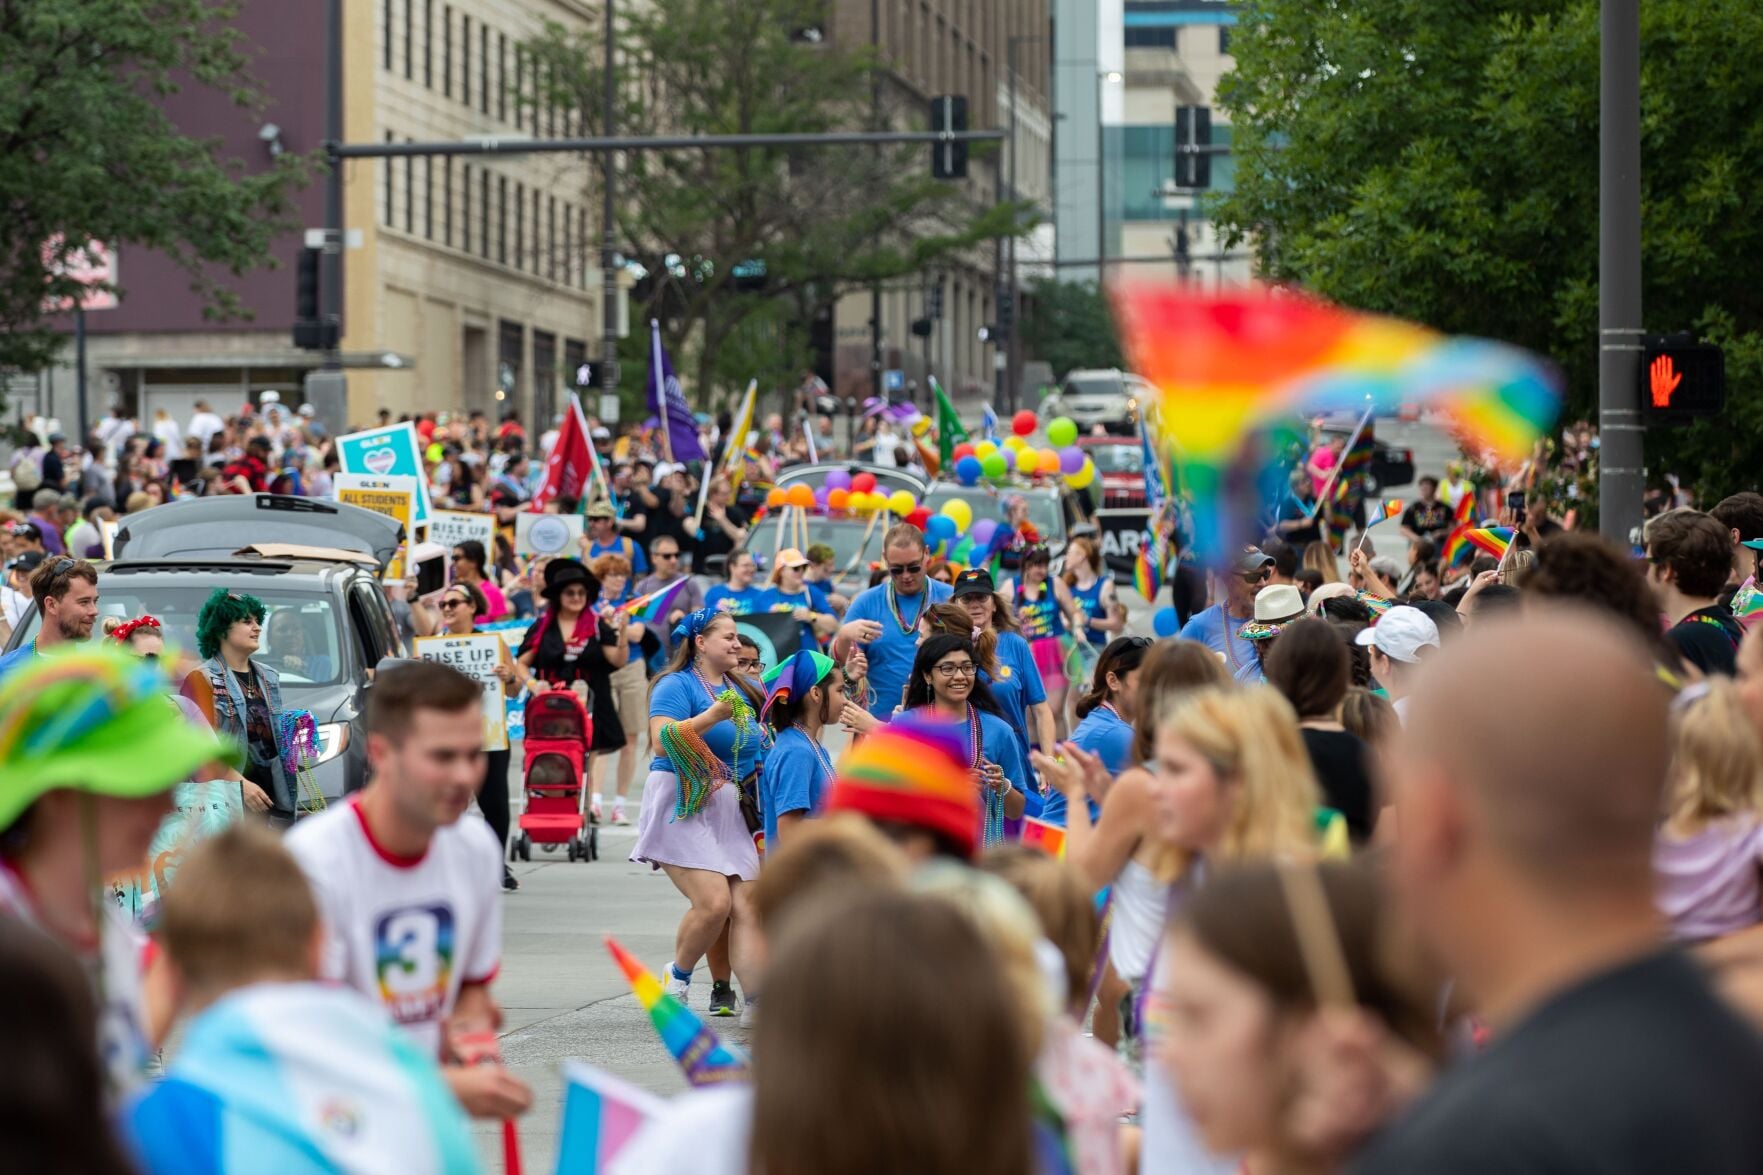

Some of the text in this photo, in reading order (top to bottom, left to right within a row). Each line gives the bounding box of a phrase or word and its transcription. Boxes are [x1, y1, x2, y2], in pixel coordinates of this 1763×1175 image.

[343, 493, 407, 505] ALL STUDENTS
[432, 521, 489, 535] RISE UP
[1101, 529, 1150, 556] AR
[423, 649, 494, 663] RISE UP
[450, 663, 495, 671] ROTECT
[176, 801, 230, 813] ETHER
[386, 911, 440, 997] 3
